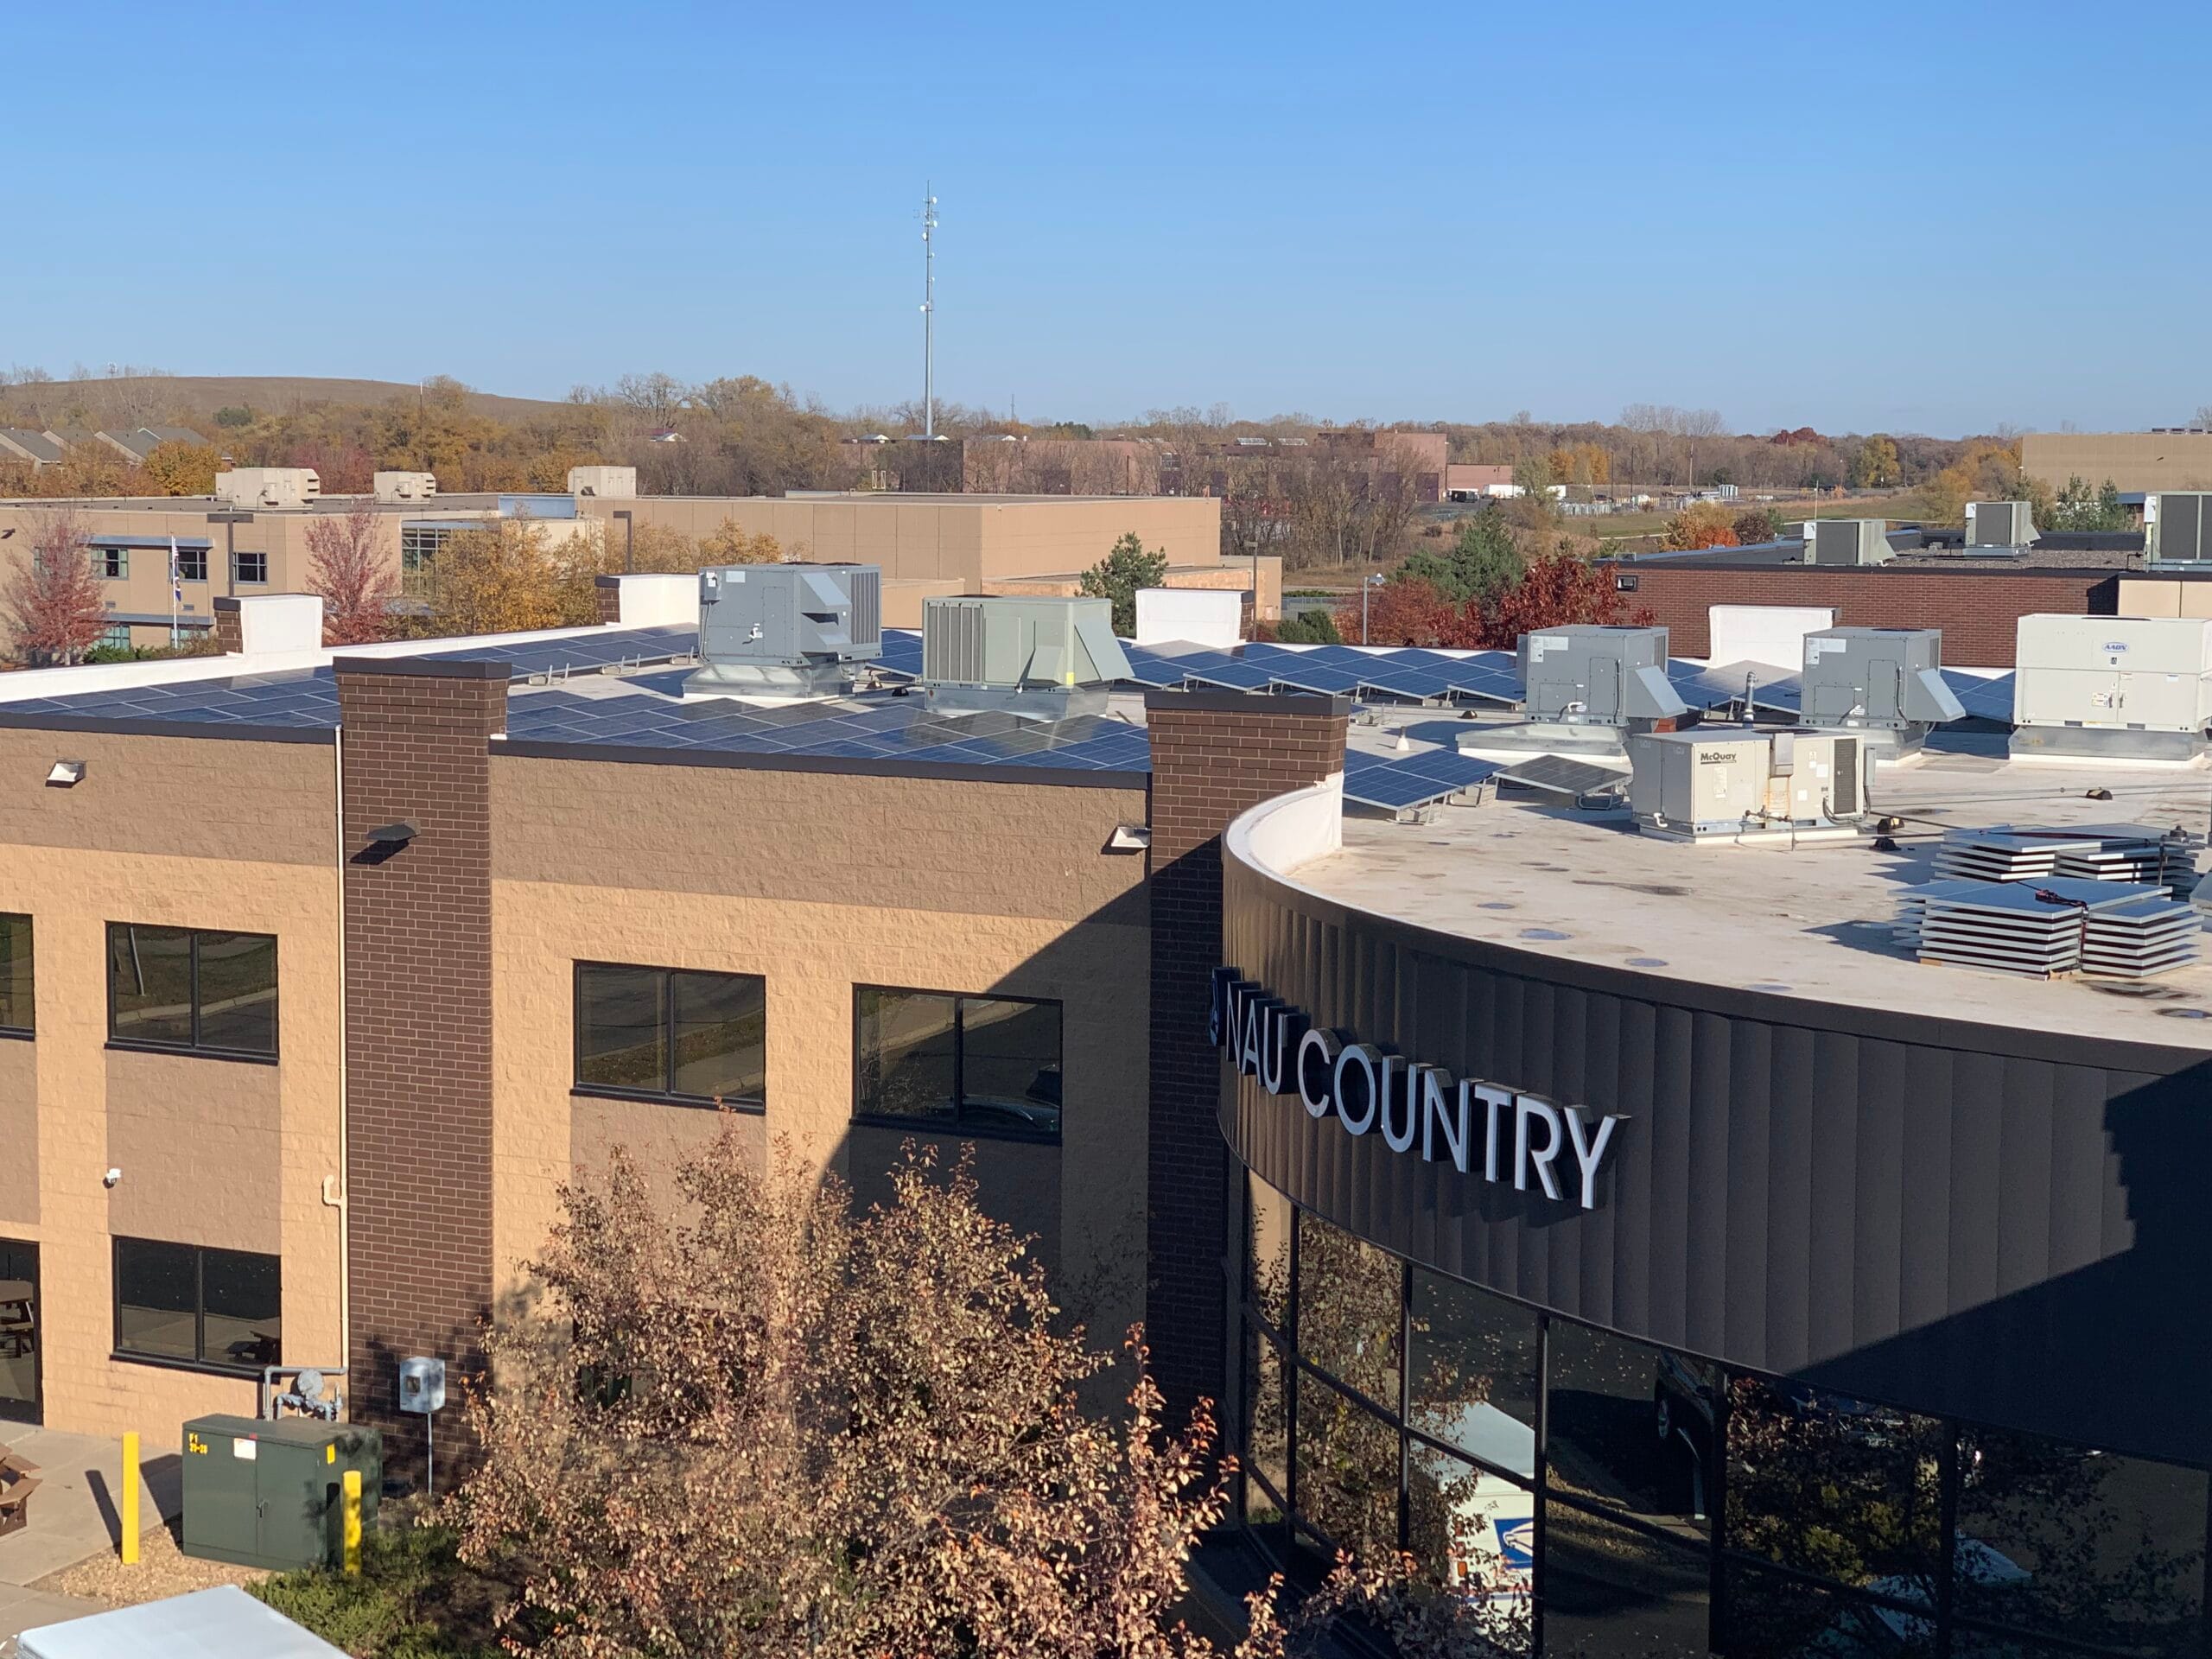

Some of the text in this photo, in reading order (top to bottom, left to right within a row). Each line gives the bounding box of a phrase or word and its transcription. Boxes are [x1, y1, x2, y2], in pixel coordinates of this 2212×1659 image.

[1700, 752, 1737, 761] McQuay
[1226, 981, 1621, 1210] NAU COUNTRY
